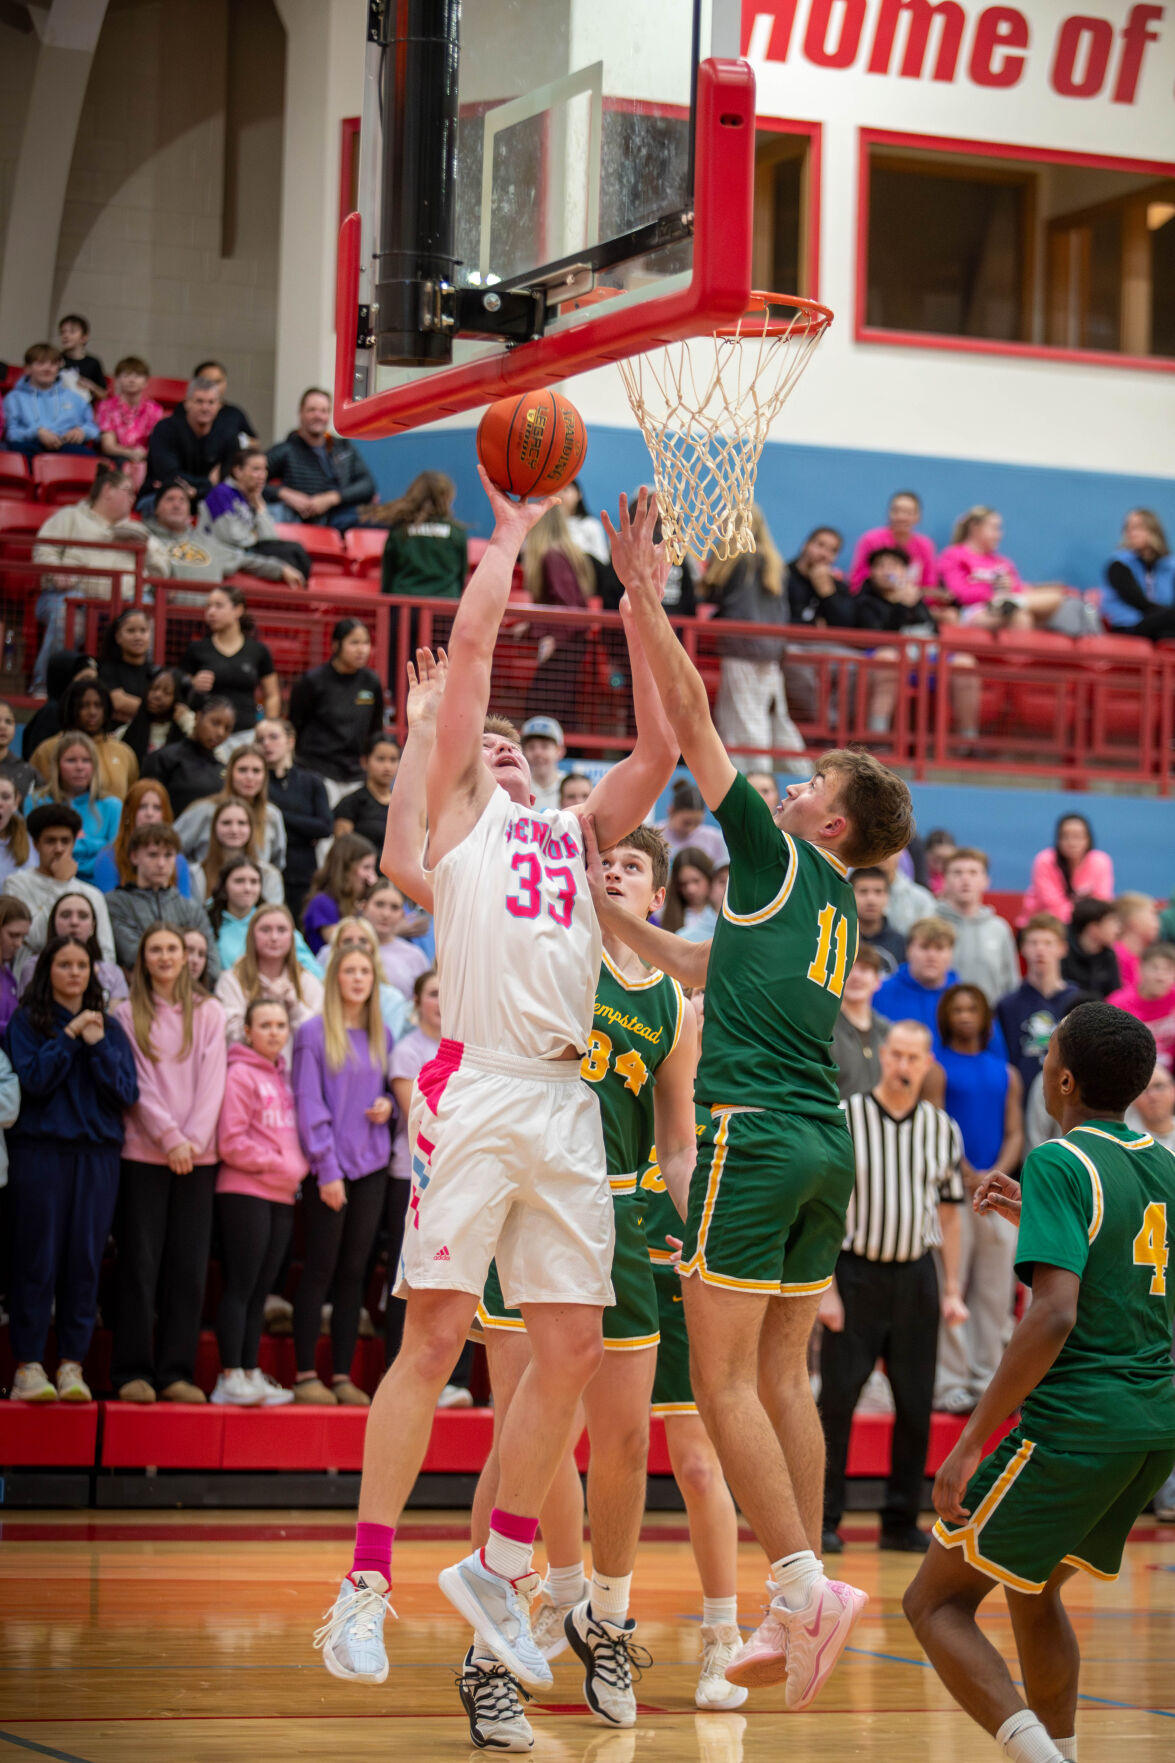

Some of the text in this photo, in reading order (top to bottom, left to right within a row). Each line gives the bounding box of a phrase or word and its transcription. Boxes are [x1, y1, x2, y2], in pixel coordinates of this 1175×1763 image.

[1050, 4, 1165, 105] of
[528, 405, 549, 470] LEGACY
[547, 407, 576, 481] SPALDING
[506, 851, 577, 929] 33
[807, 901, 847, 999] 11
[593, 994, 663, 1044] empstead
[580, 1029, 649, 1097] 34
[1133, 1201, 1169, 1296] 4
